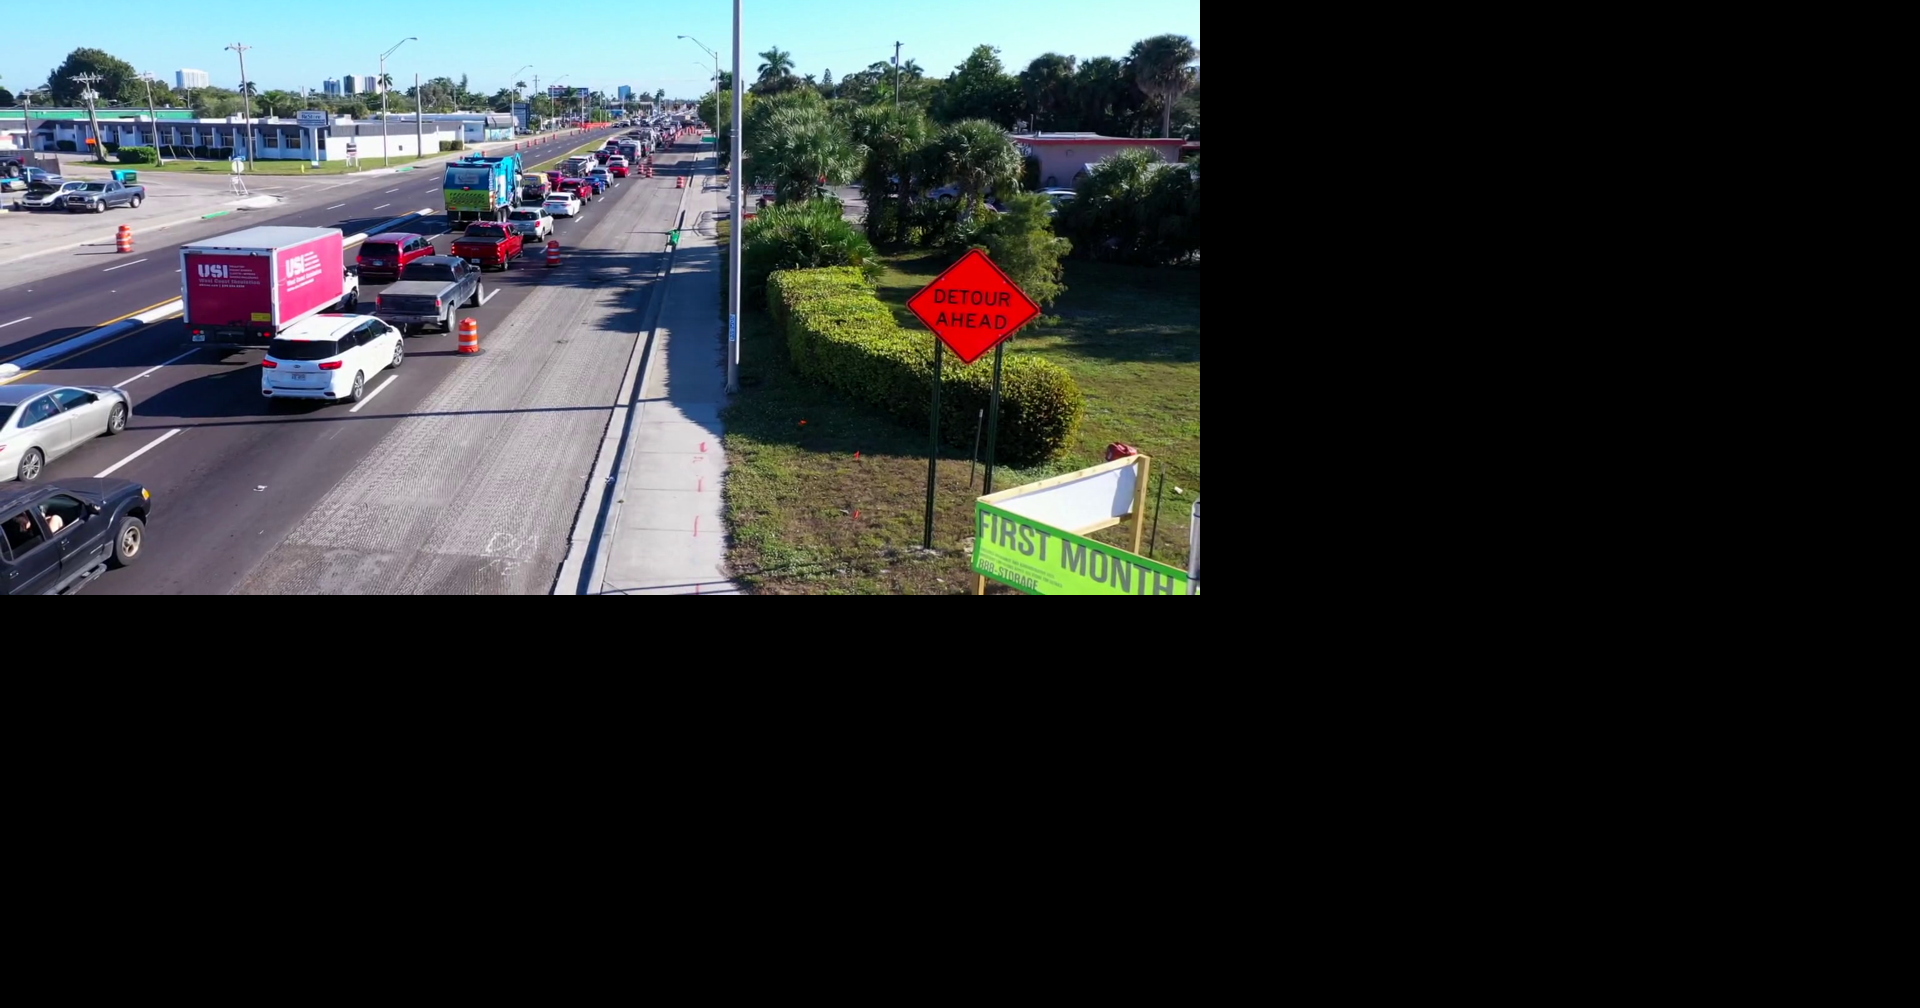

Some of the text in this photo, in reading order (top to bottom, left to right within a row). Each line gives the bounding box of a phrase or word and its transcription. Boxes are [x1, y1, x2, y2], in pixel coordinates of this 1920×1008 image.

[198, 264, 228, 278] USI
[286, 254, 305, 278] USI
[934, 289, 1011, 306] DETOUR
[936, 312, 1008, 330] AHEAD
[980, 510, 1051, 561] FIRST
[1061, 538, 1174, 595] MONTH
[978, 558, 1039, 590] 888-STORAGE
